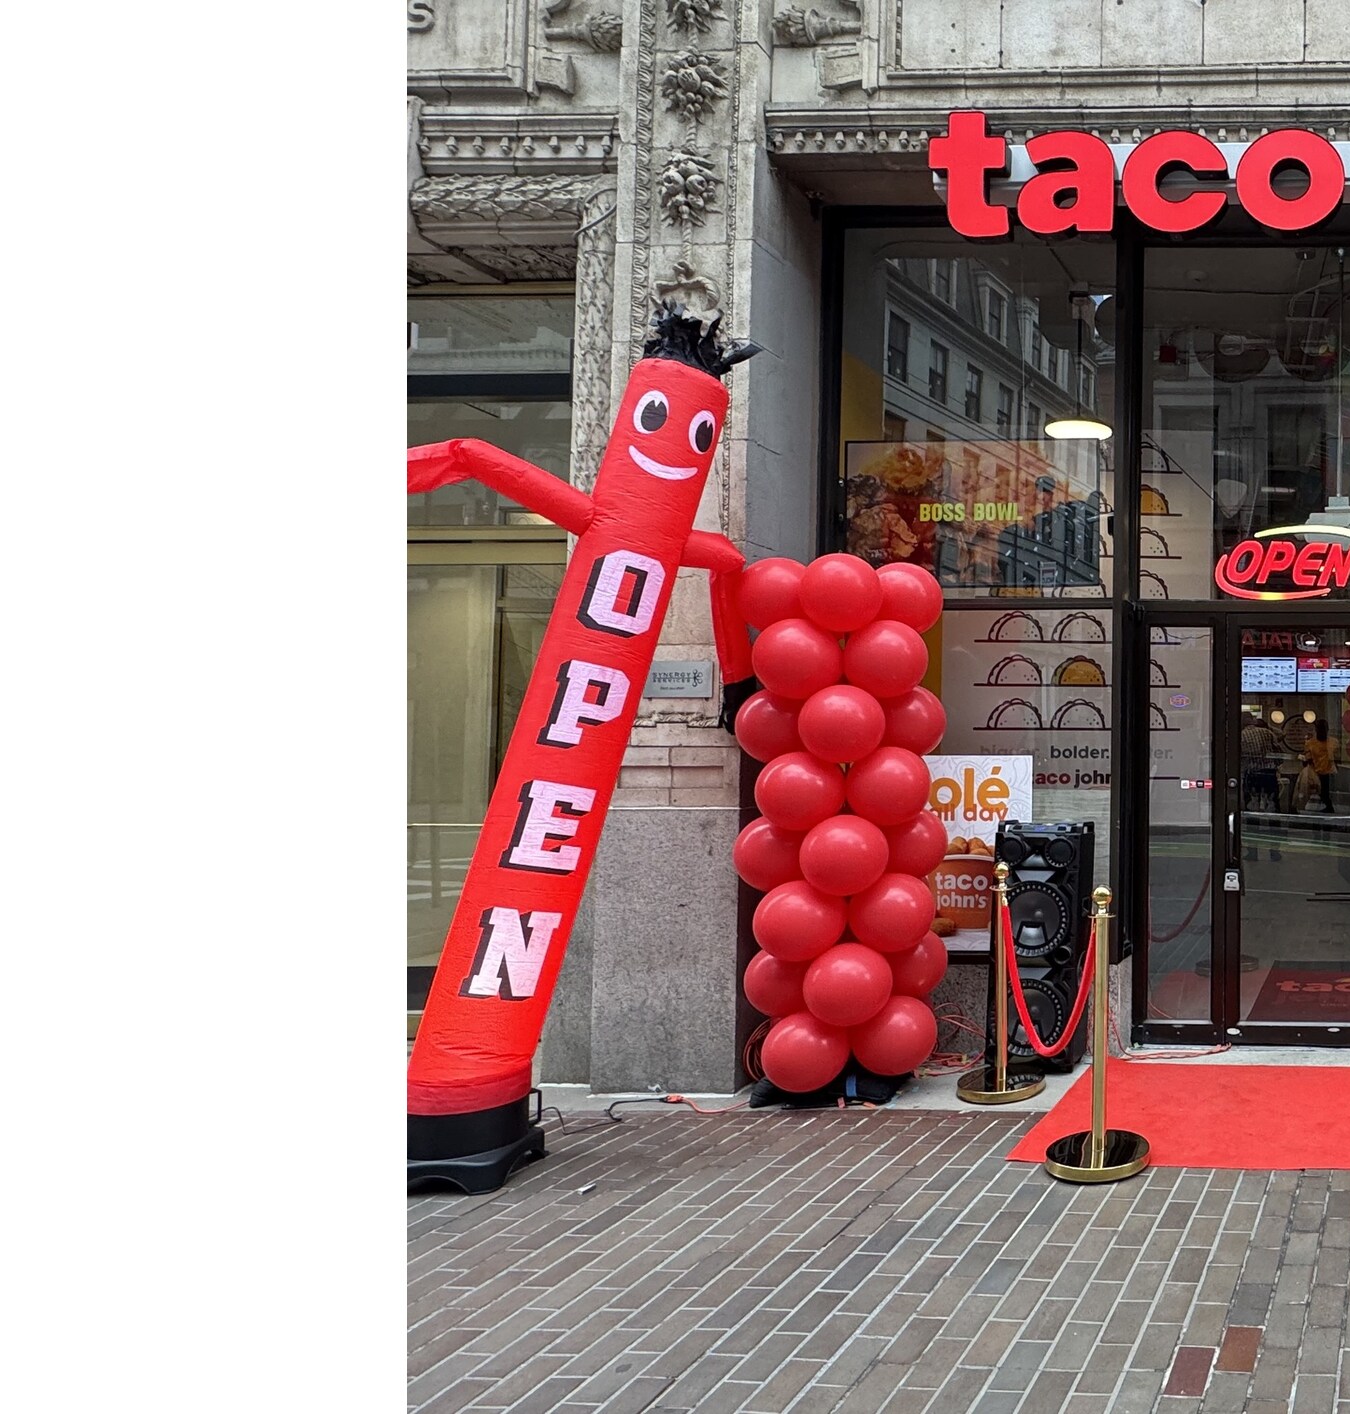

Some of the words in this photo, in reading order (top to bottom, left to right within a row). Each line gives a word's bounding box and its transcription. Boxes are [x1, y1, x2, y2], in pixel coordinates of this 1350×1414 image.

[928, 111, 1345, 237] taco
[920, 503, 965, 522] BOSS
[974, 502, 1023, 521] BOWL
[1050, 745, 1110, 760] bolder.
[458, 549, 665, 1001] OPEN
[1032, 773, 1071, 786] aco
[930, 766, 1010, 811] olé
[935, 872, 988, 890] taco
[936, 892, 987, 911] john's
